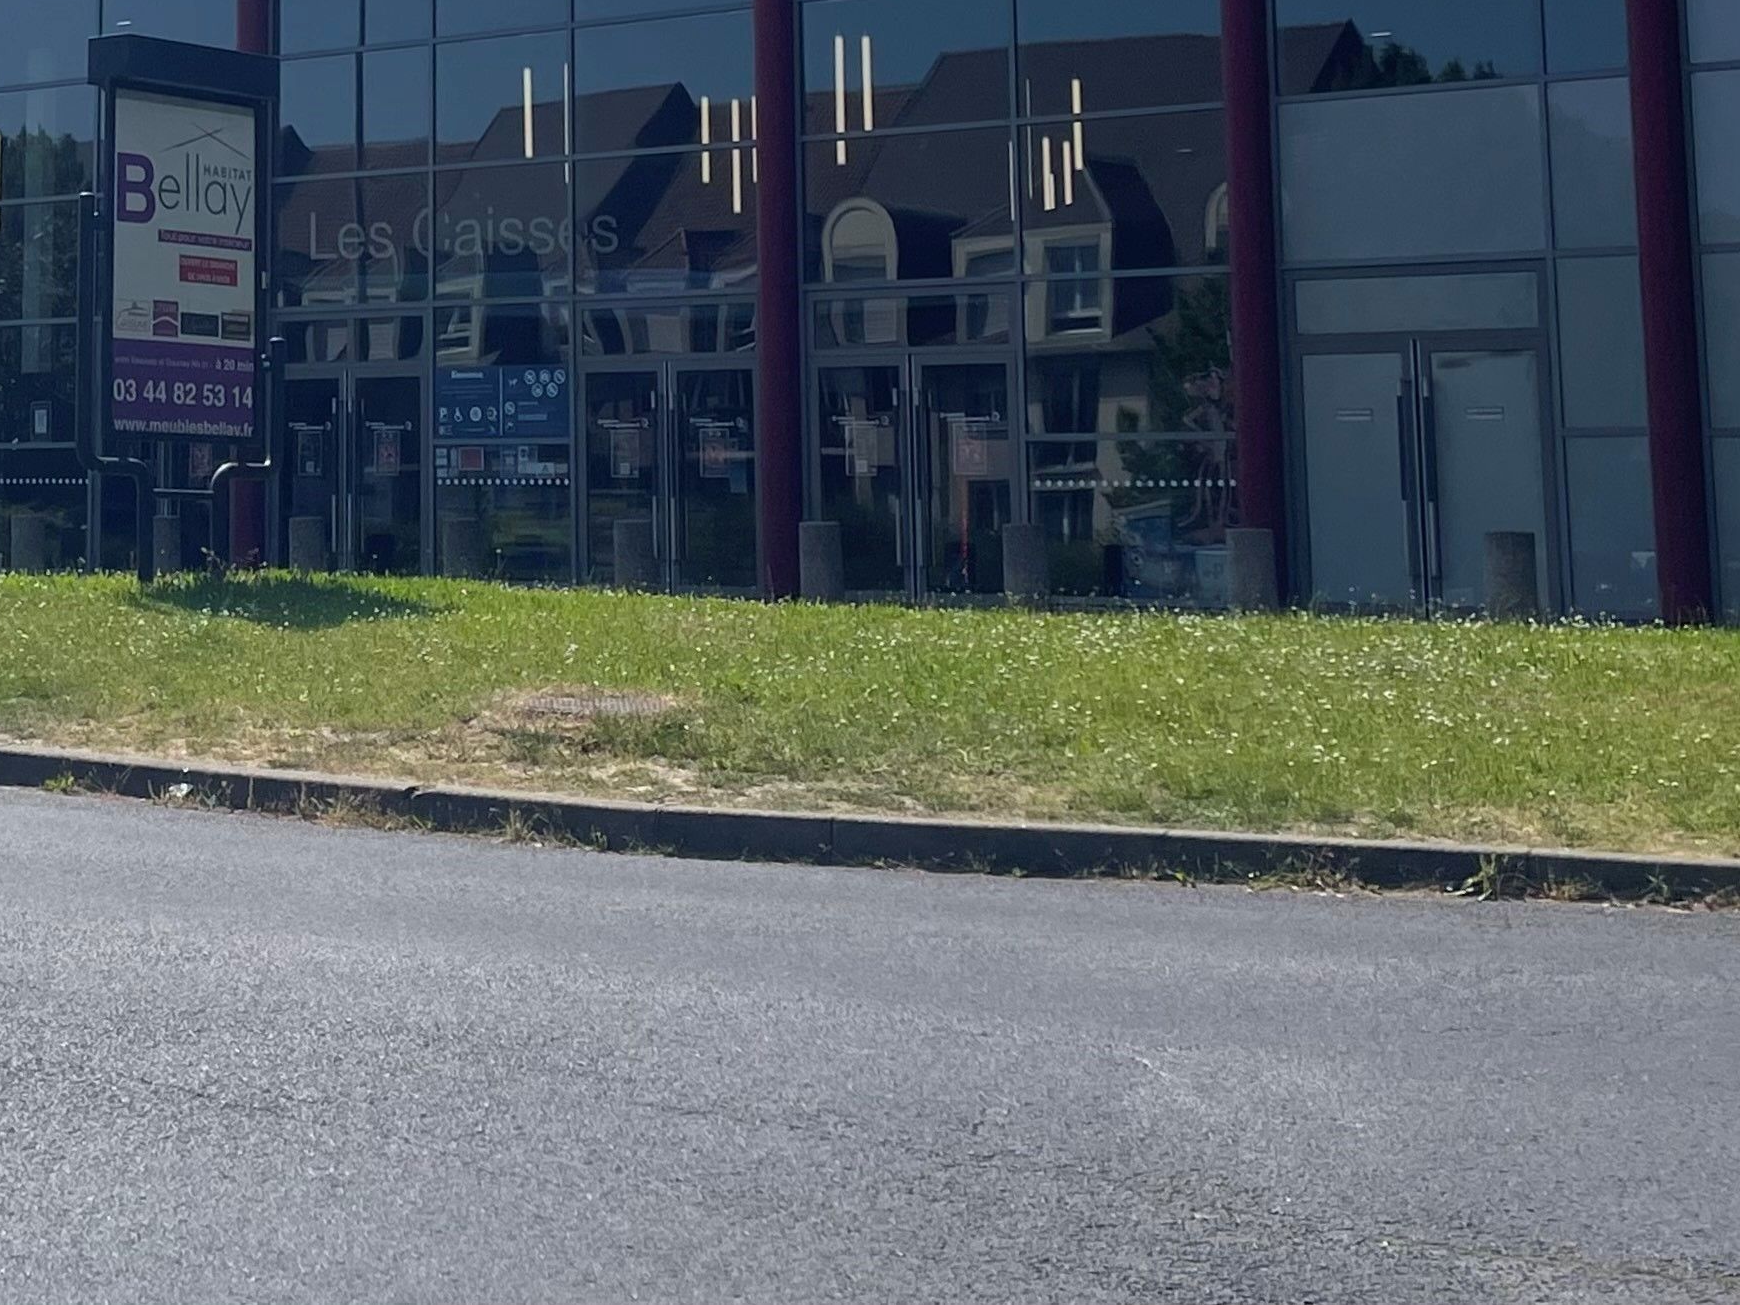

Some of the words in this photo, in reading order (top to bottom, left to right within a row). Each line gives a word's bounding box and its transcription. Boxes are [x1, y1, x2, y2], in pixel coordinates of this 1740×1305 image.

[203, 163, 252, 181] HABITAT
[117, 151, 251, 235] Bellay
[310, 211, 395, 261] Les
[223, 359, 235, 371] 20
[113, 378, 137, 402] 03
[143, 380, 167, 404] 44
[173, 382, 197, 405] 82
[202, 384, 226, 407] 53
[232, 386, 253, 409] 14
